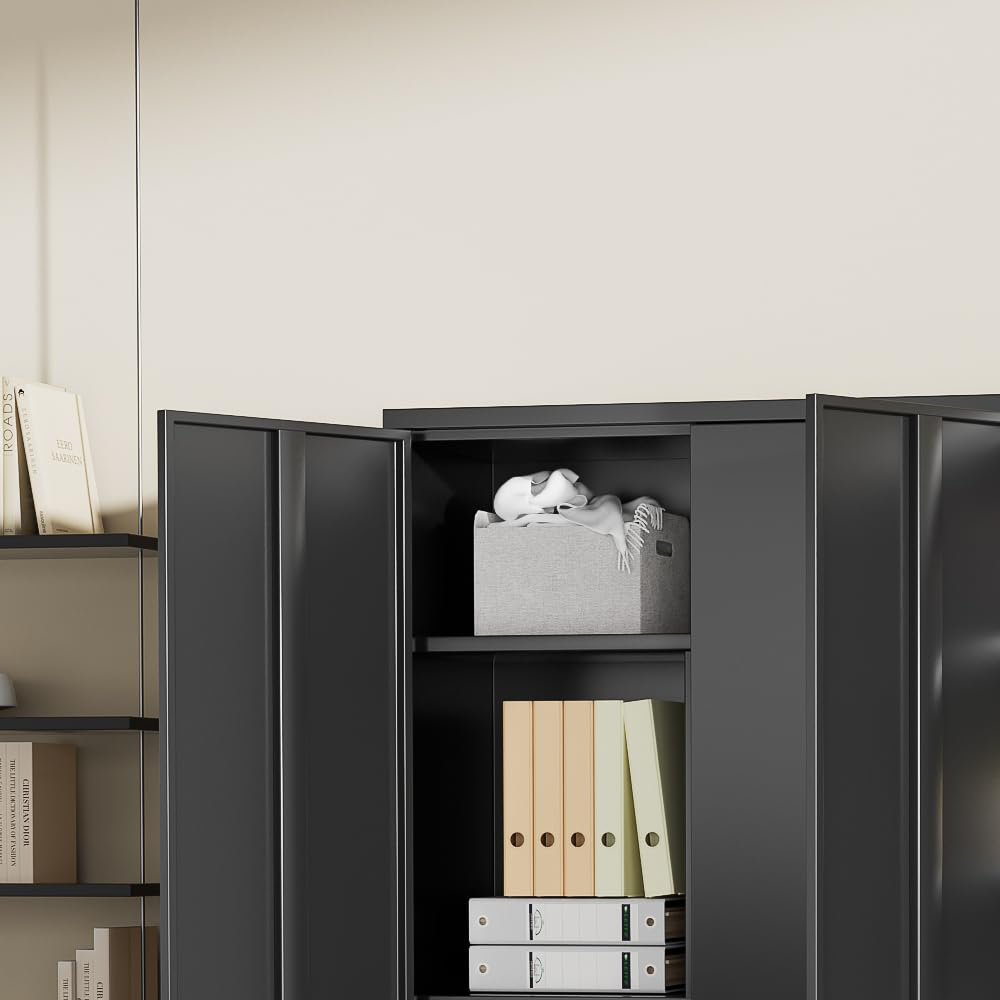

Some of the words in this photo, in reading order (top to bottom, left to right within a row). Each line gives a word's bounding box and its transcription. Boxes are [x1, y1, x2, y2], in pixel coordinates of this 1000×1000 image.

[3, 393, 13, 452] ROADS
[22, 779, 30, 823] CHRISTIAN
[22, 825, 30, 847] DIOR
